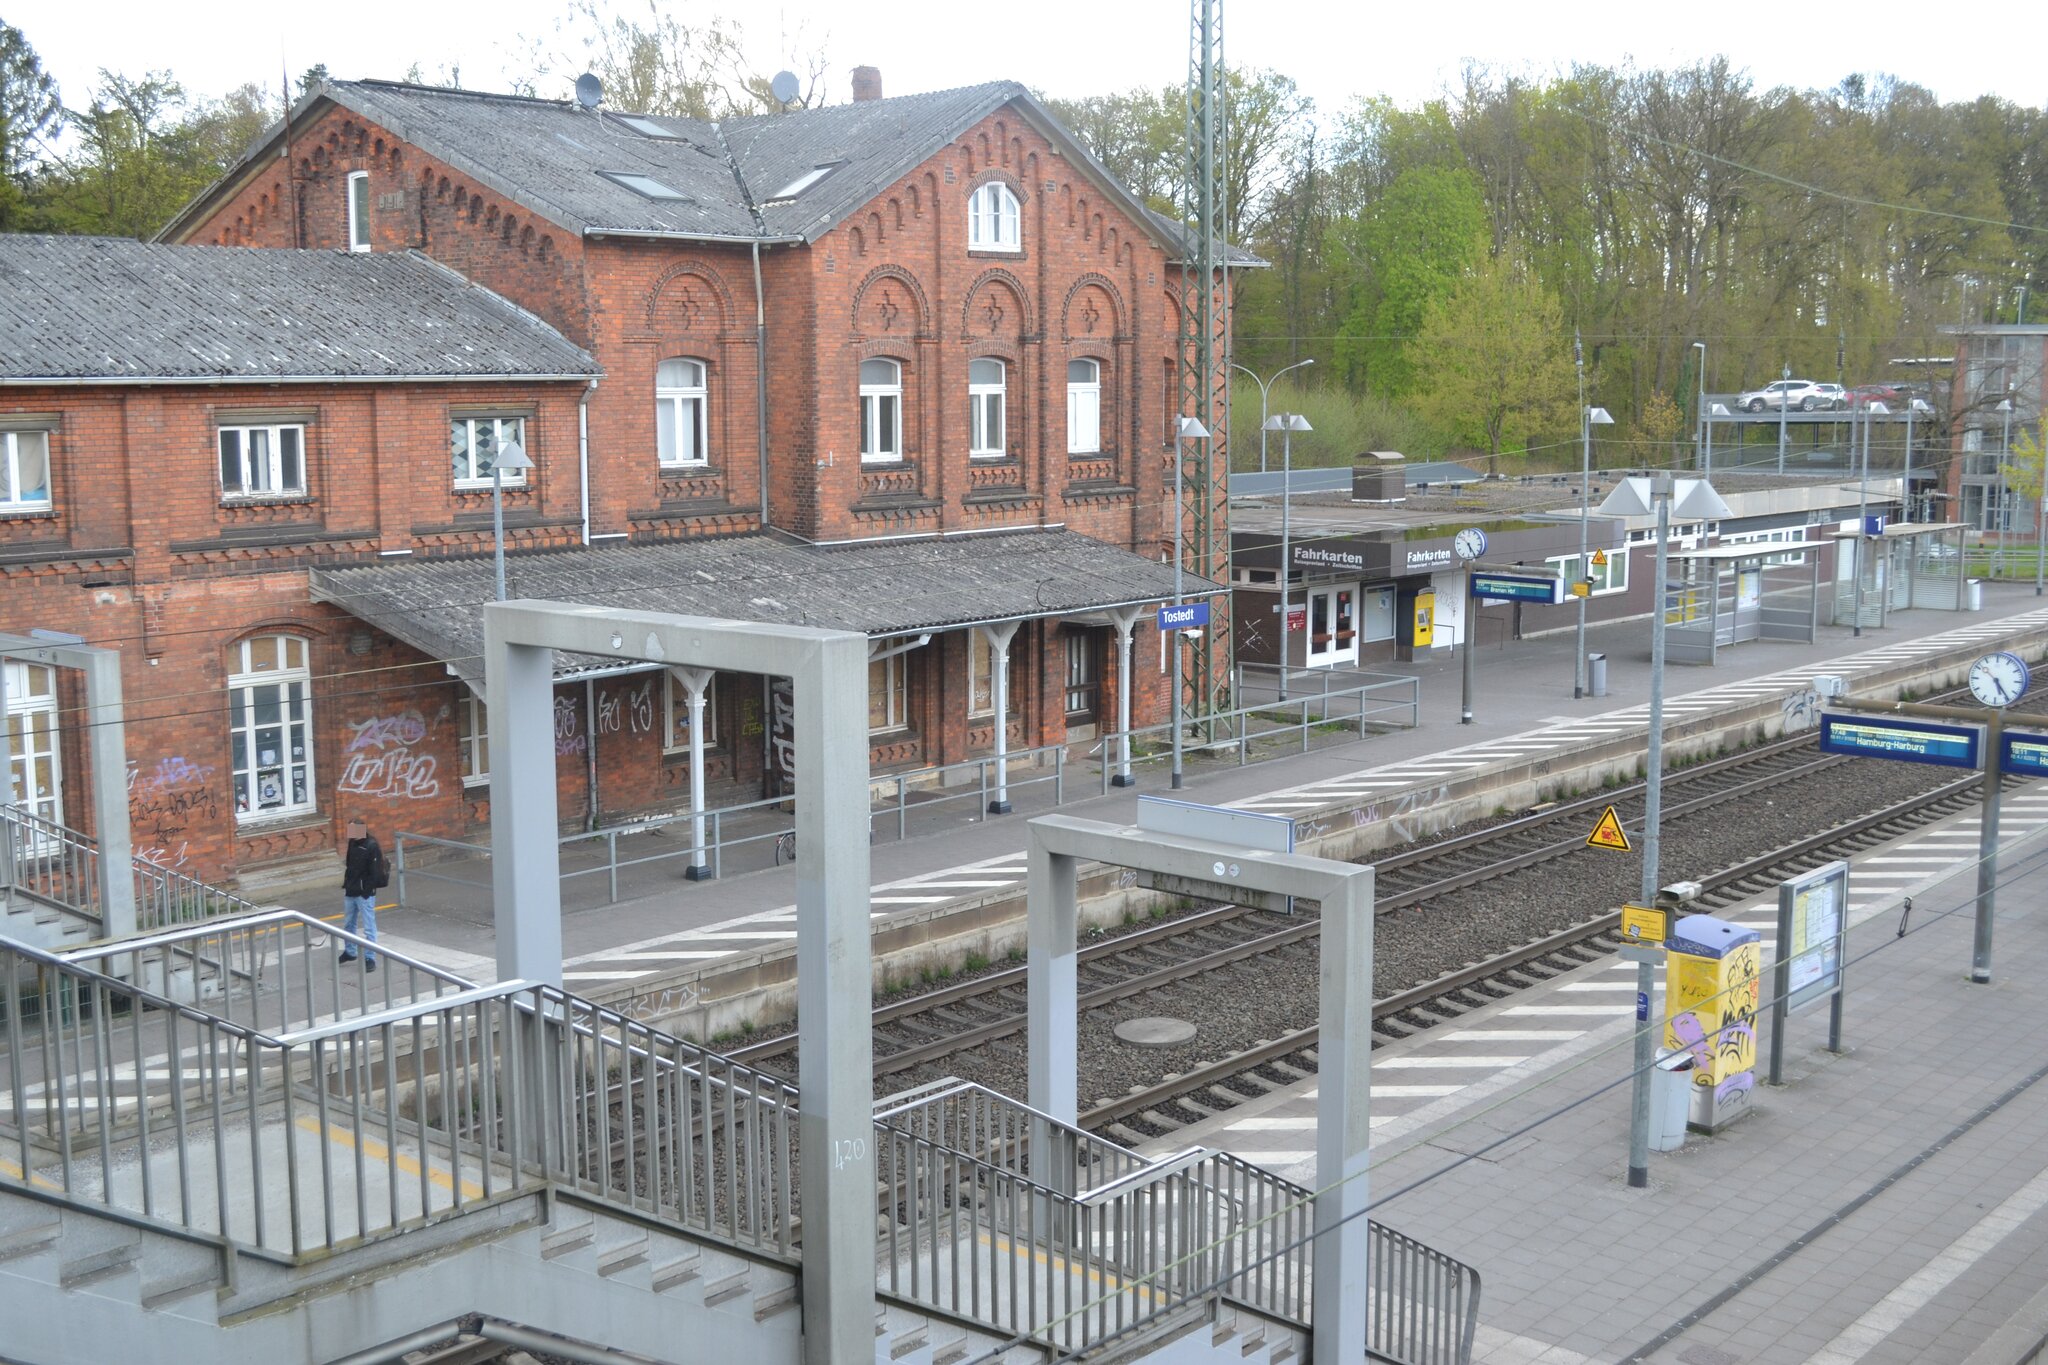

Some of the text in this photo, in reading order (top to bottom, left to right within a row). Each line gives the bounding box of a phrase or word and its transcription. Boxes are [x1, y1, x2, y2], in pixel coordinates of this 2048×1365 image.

[1875, 516, 1882, 531] 1
[1294, 547, 1363, 564] Fahrkarten
[1407, 549, 1451, 563] Fahrkarten
[1162, 608, 1194, 624] Tostedt
[1856, 737, 1925, 753] Hamburg-Harburg
[834, 1137, 866, 1171] 420
